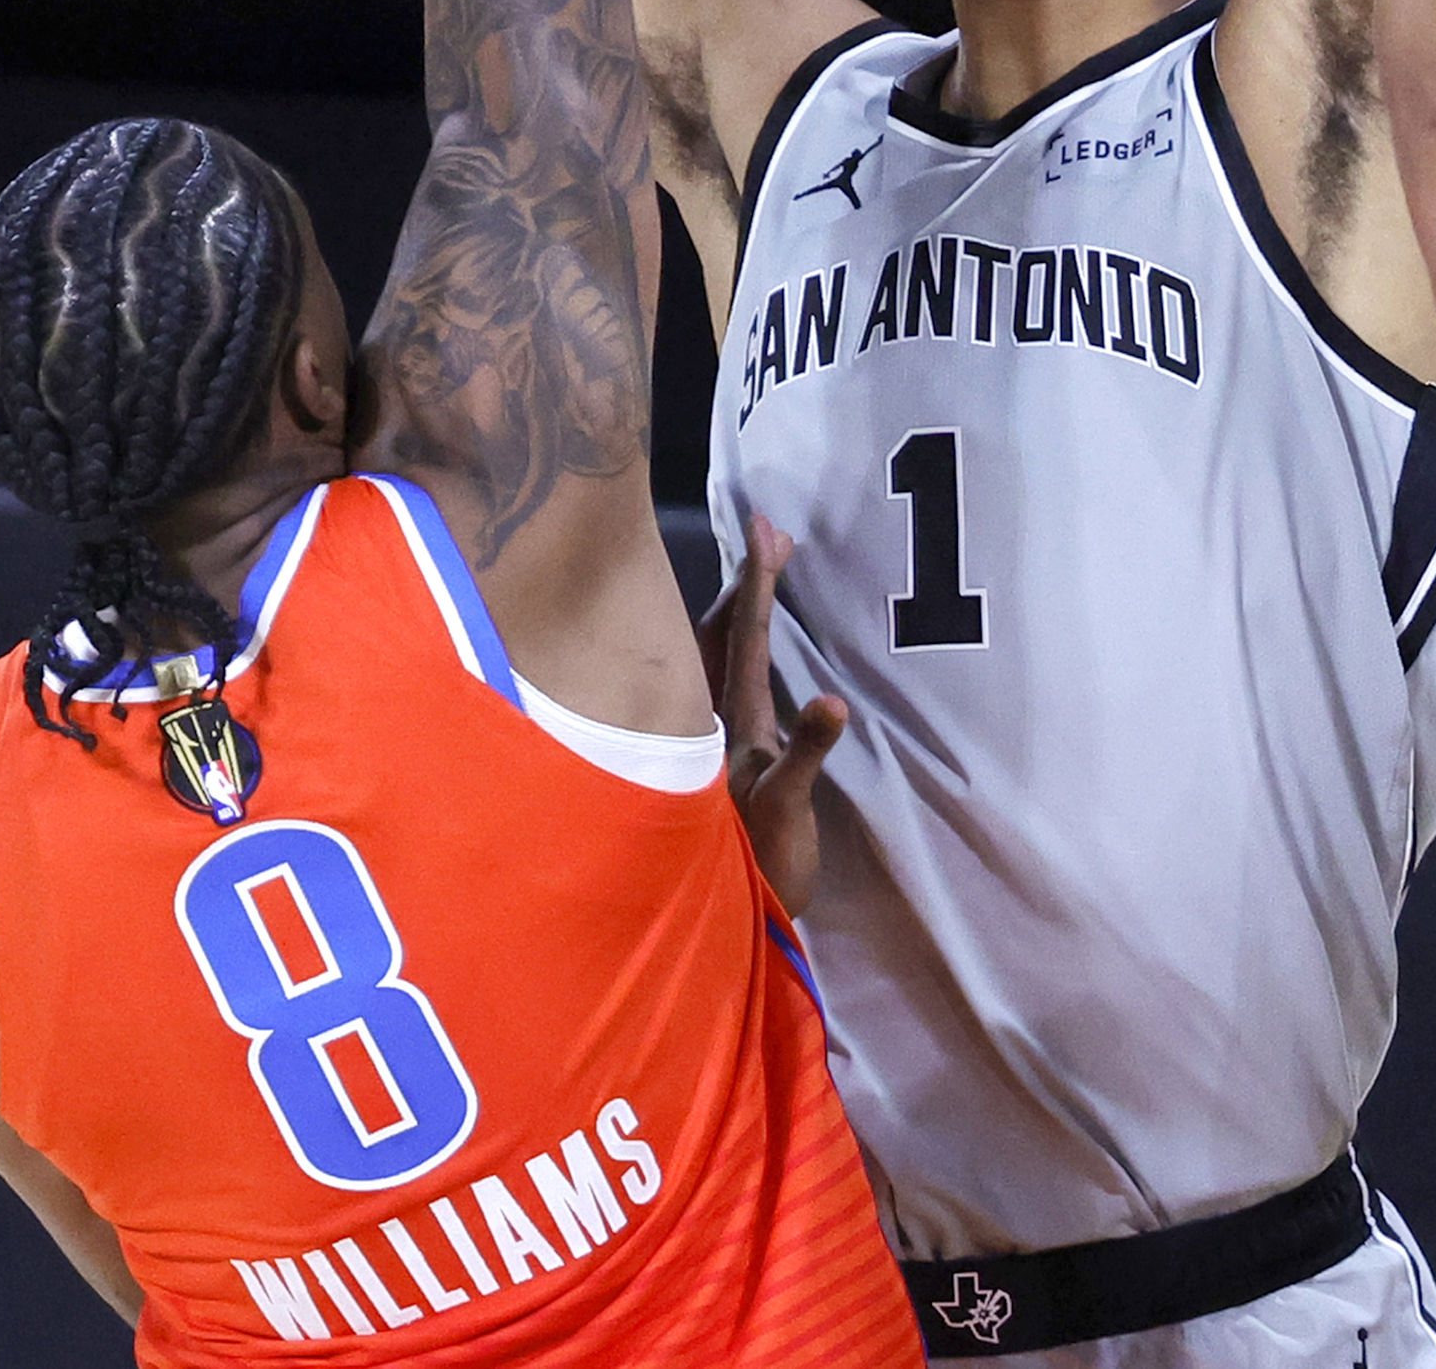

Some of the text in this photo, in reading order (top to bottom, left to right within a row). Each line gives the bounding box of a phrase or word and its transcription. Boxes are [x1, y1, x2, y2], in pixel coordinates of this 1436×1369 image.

[1060, 129, 1157, 166] LEDGER
[737, 233, 1205, 438] SAN ANTONIO
[886, 425, 989, 654] 1
[174, 818, 479, 1191] 8
[229, 1097, 662, 1342] WILLIAMS
